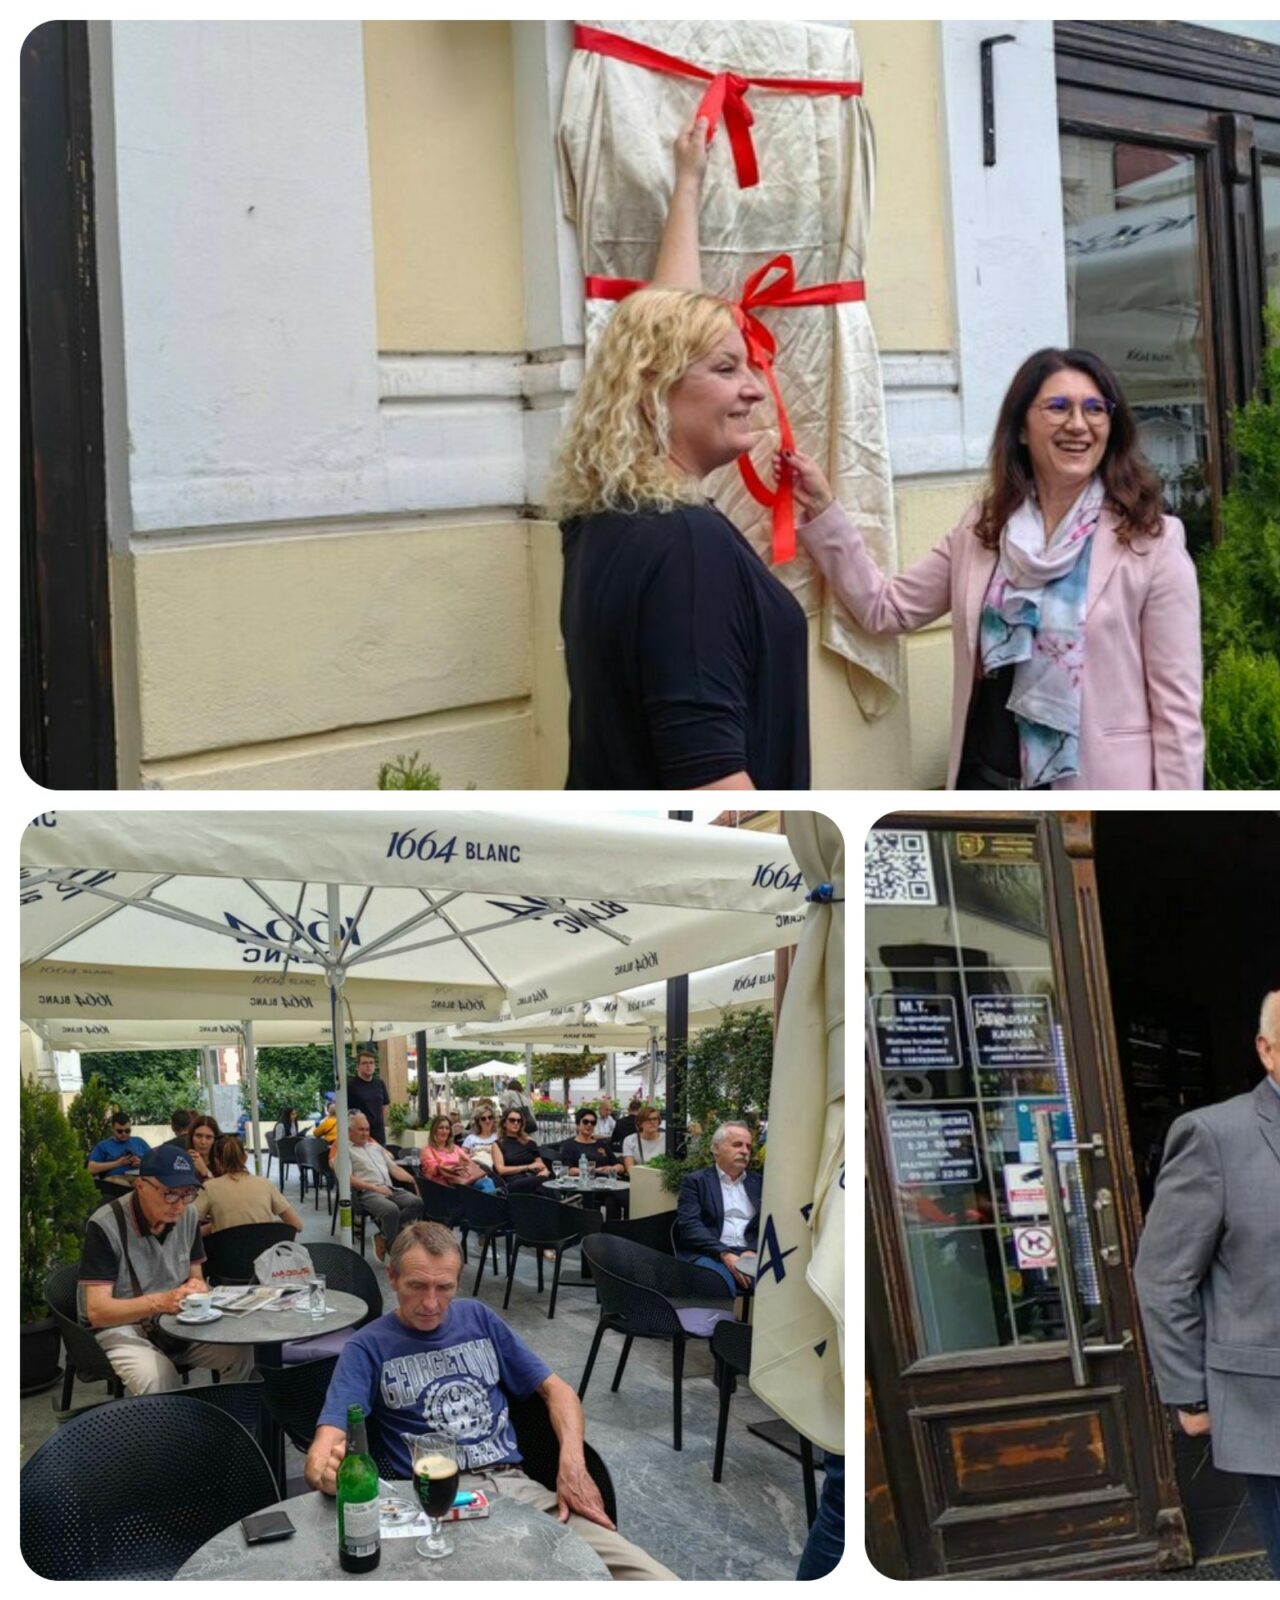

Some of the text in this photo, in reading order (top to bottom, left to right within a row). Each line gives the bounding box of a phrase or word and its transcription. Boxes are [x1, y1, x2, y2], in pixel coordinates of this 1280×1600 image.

[386, 828, 520, 863] 1664 BLANC
[752, 861, 804, 892] 1664
